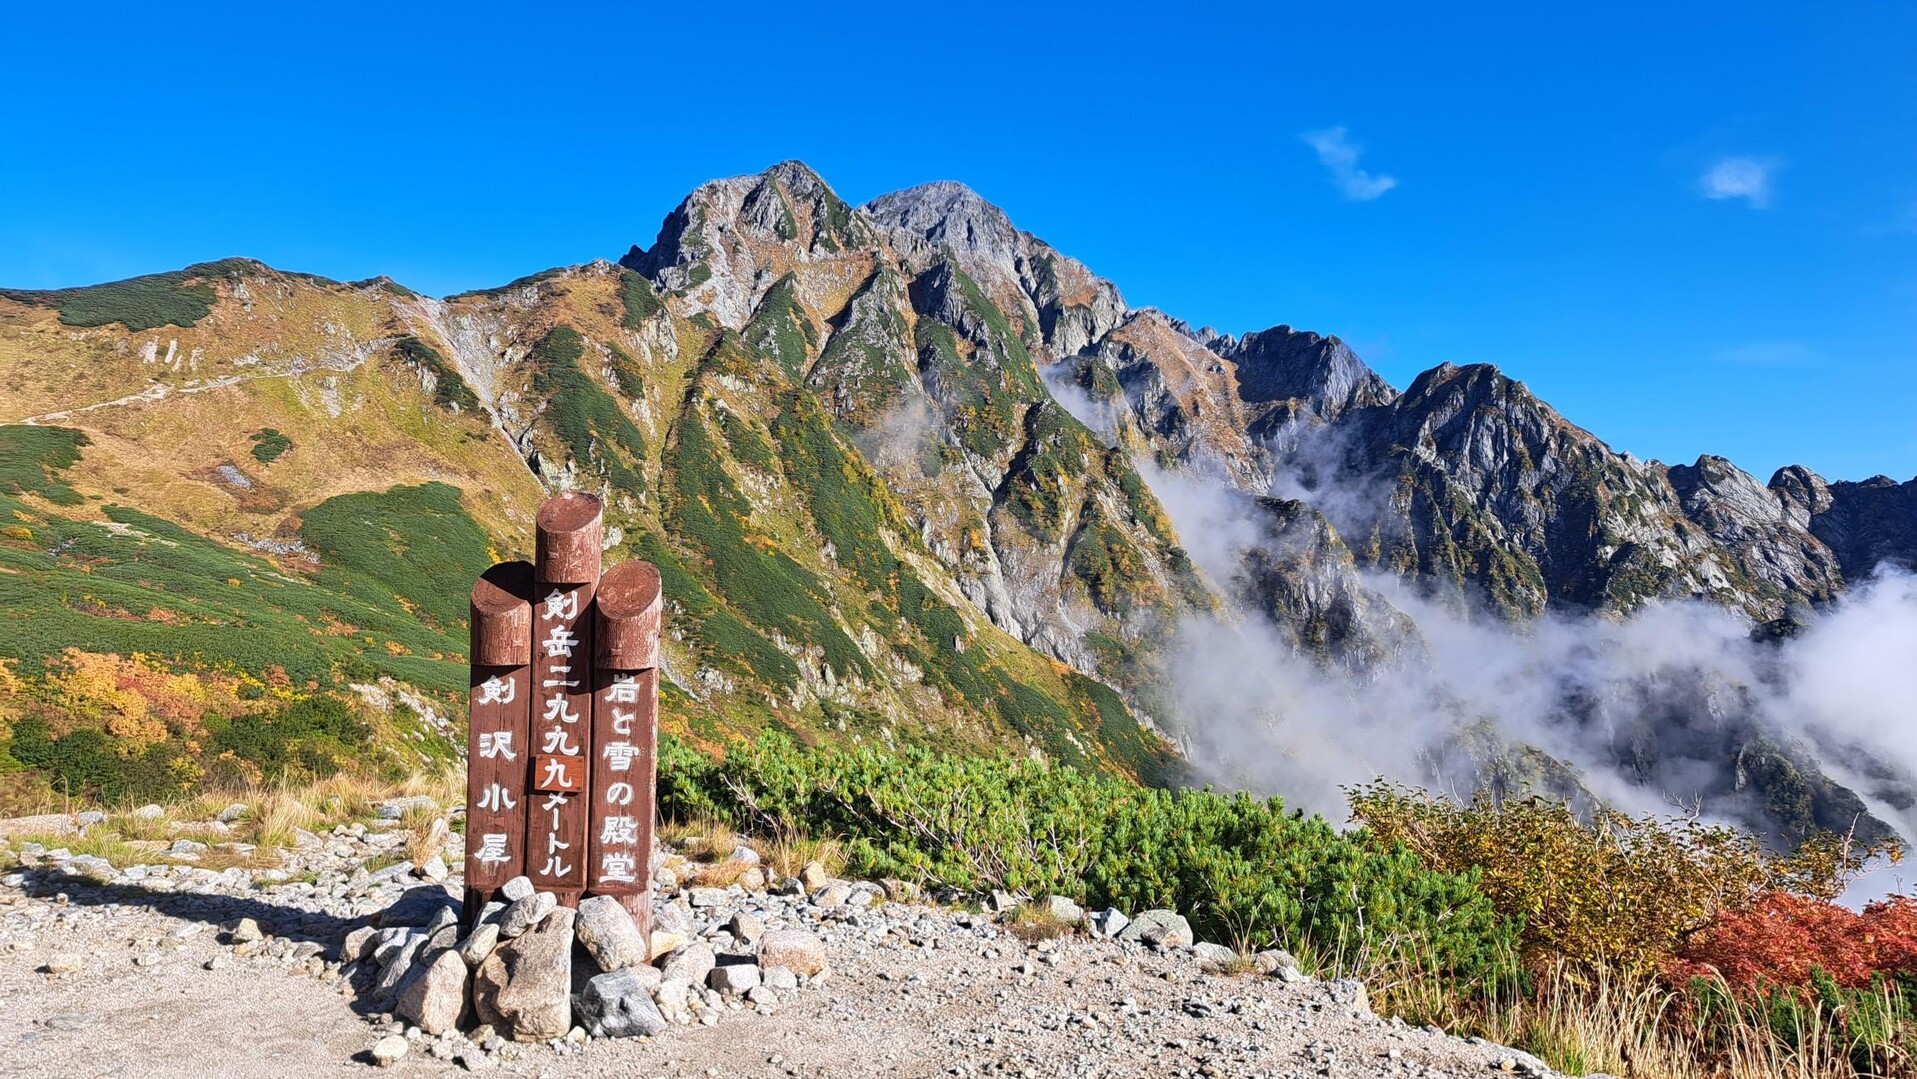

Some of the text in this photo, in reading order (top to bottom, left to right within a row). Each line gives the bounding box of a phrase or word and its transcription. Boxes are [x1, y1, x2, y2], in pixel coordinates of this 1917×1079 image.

[475, 675, 517, 864] 剣沢小屋
[540, 588, 580, 878] 剣岳二九九九メートル
[598, 673, 640, 882] 岩と雪の殿堂
